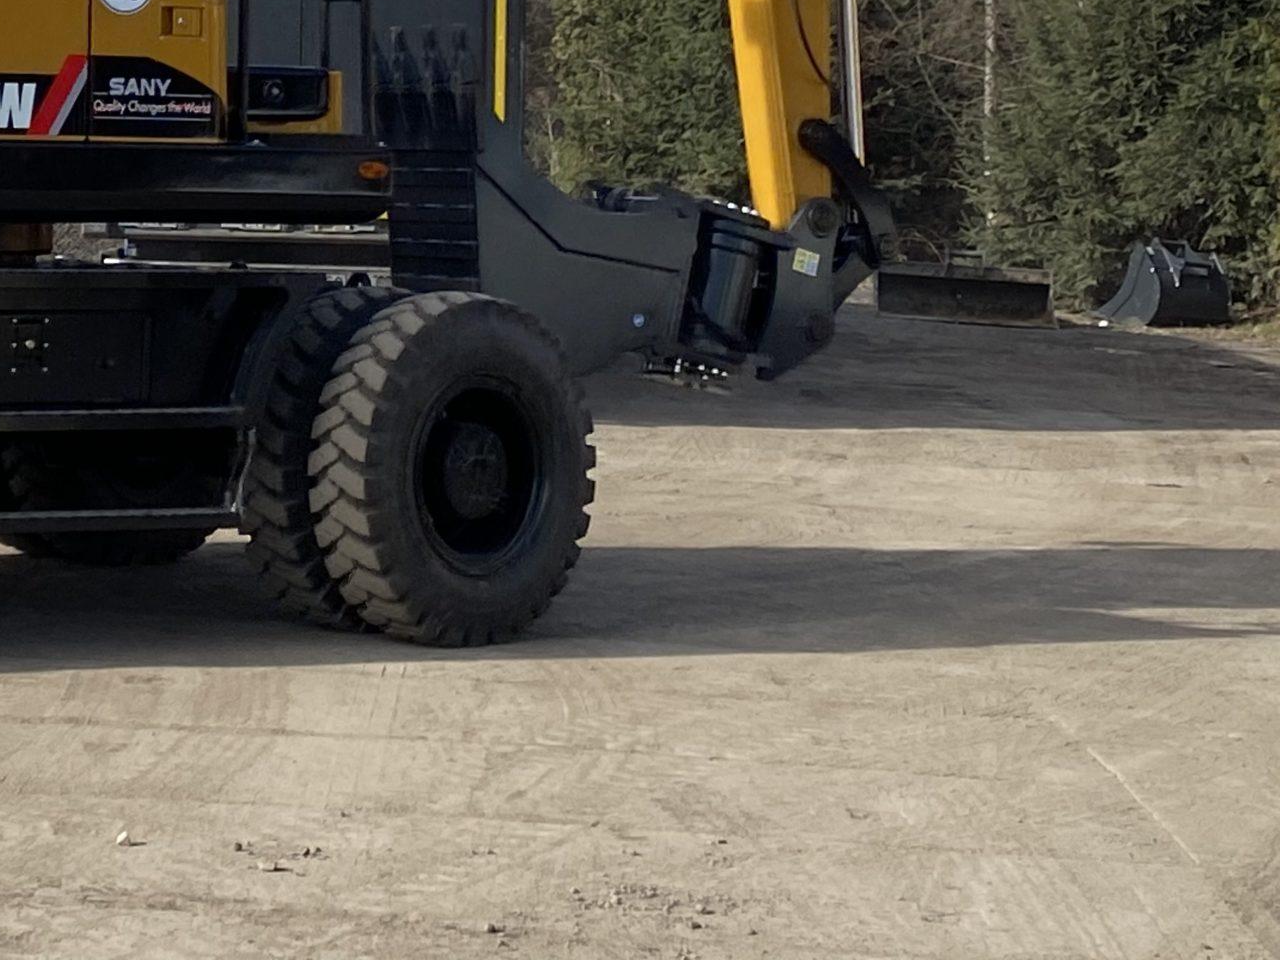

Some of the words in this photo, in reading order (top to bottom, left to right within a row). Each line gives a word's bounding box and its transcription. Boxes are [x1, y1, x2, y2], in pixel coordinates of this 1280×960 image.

[108, 77, 172, 97] SANY
[93, 99, 126, 115] Quality
[127, 100, 167, 116] Changes
